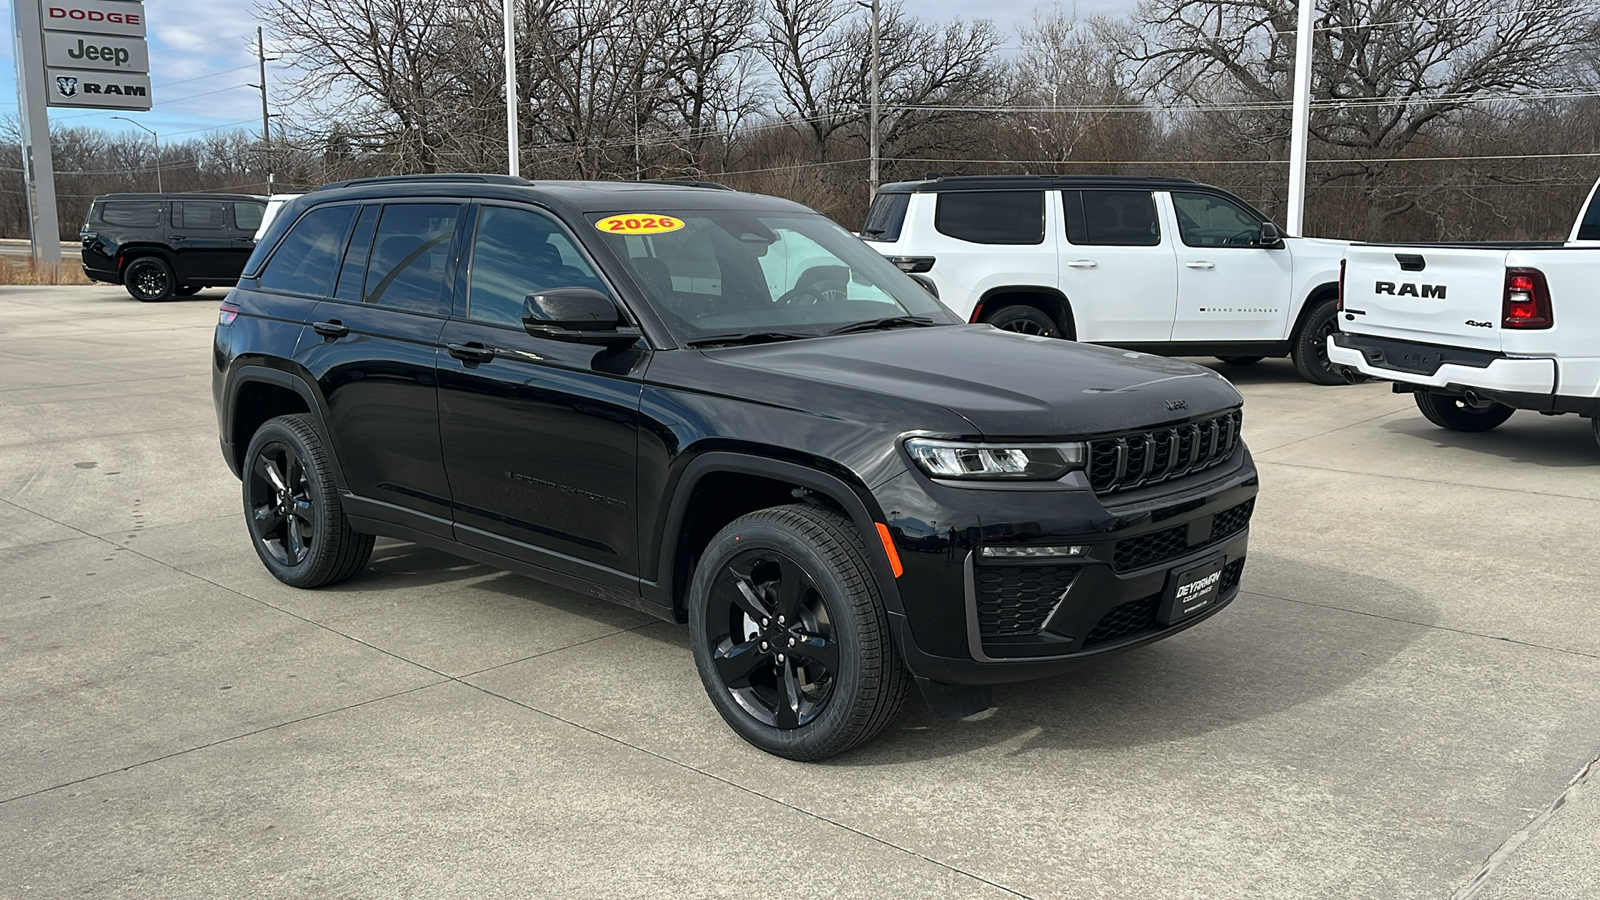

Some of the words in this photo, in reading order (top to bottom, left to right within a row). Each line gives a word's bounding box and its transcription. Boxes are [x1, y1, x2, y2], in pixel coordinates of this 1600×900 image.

[49, 7, 140, 25] DODGE
[67, 39, 130, 67] Jeep
[83, 83, 147, 97] RAM
[608, 218, 675, 231] 2026
[1375, 281, 1447, 299] RAM
[1165, 399, 1188, 411] Jeep
[1176, 570, 1222, 599] DEYARMAN
